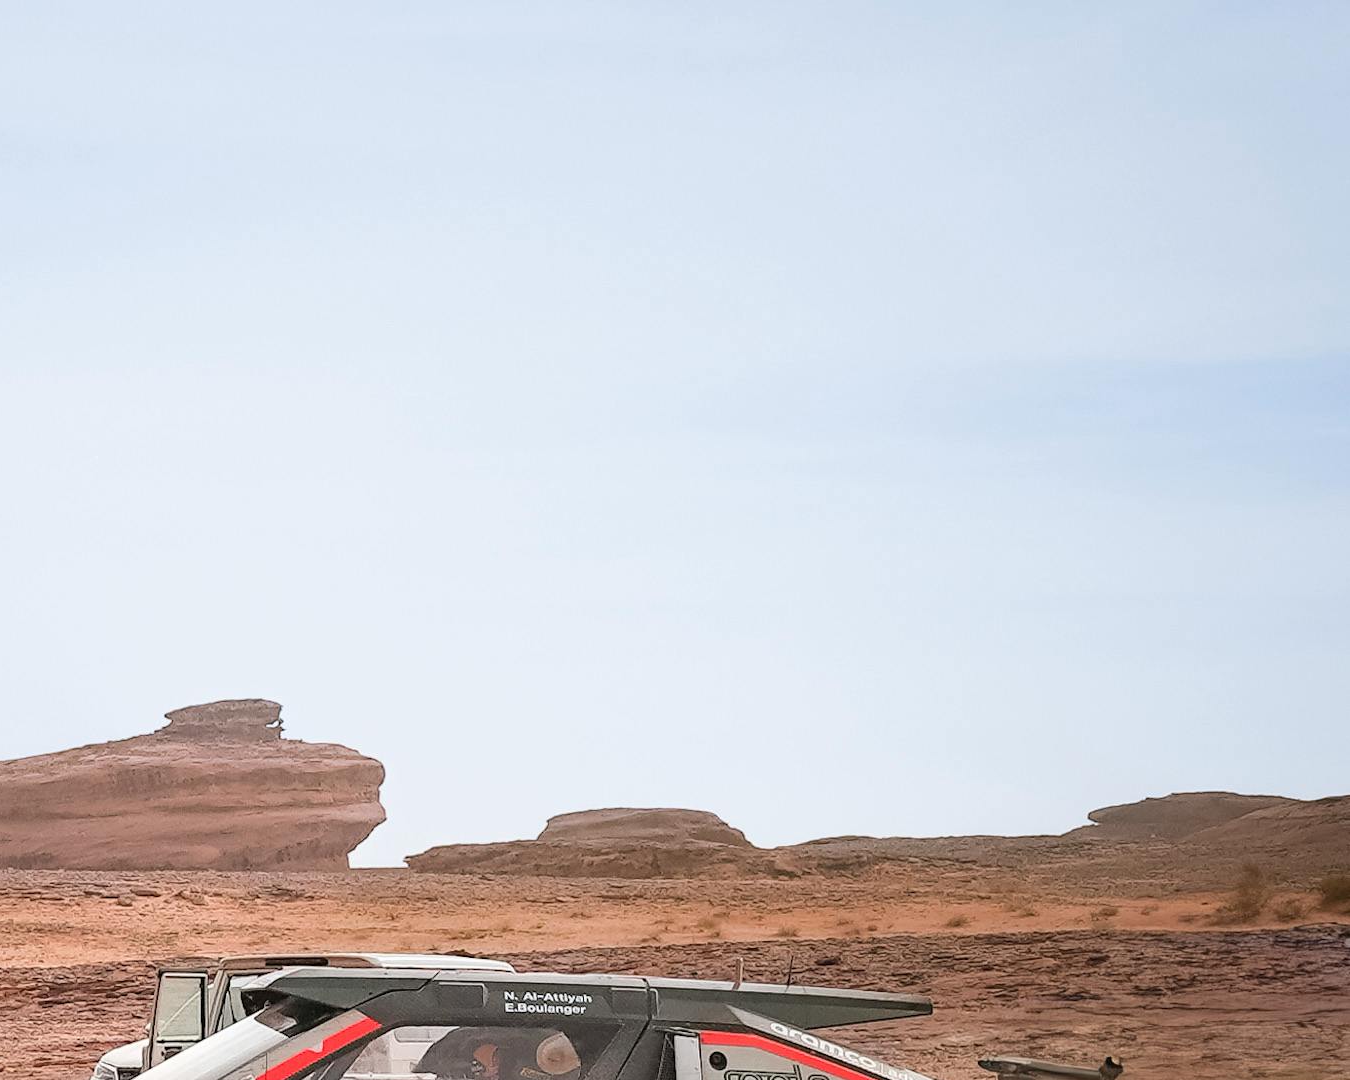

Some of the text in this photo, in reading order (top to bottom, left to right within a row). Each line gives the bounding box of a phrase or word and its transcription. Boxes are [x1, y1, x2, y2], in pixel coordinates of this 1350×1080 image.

[503, 991, 593, 1004] N. Al-Attiyah
[504, 1002, 587, 1016] E.Boulanger
[769, 1021, 877, 1073] aramco
